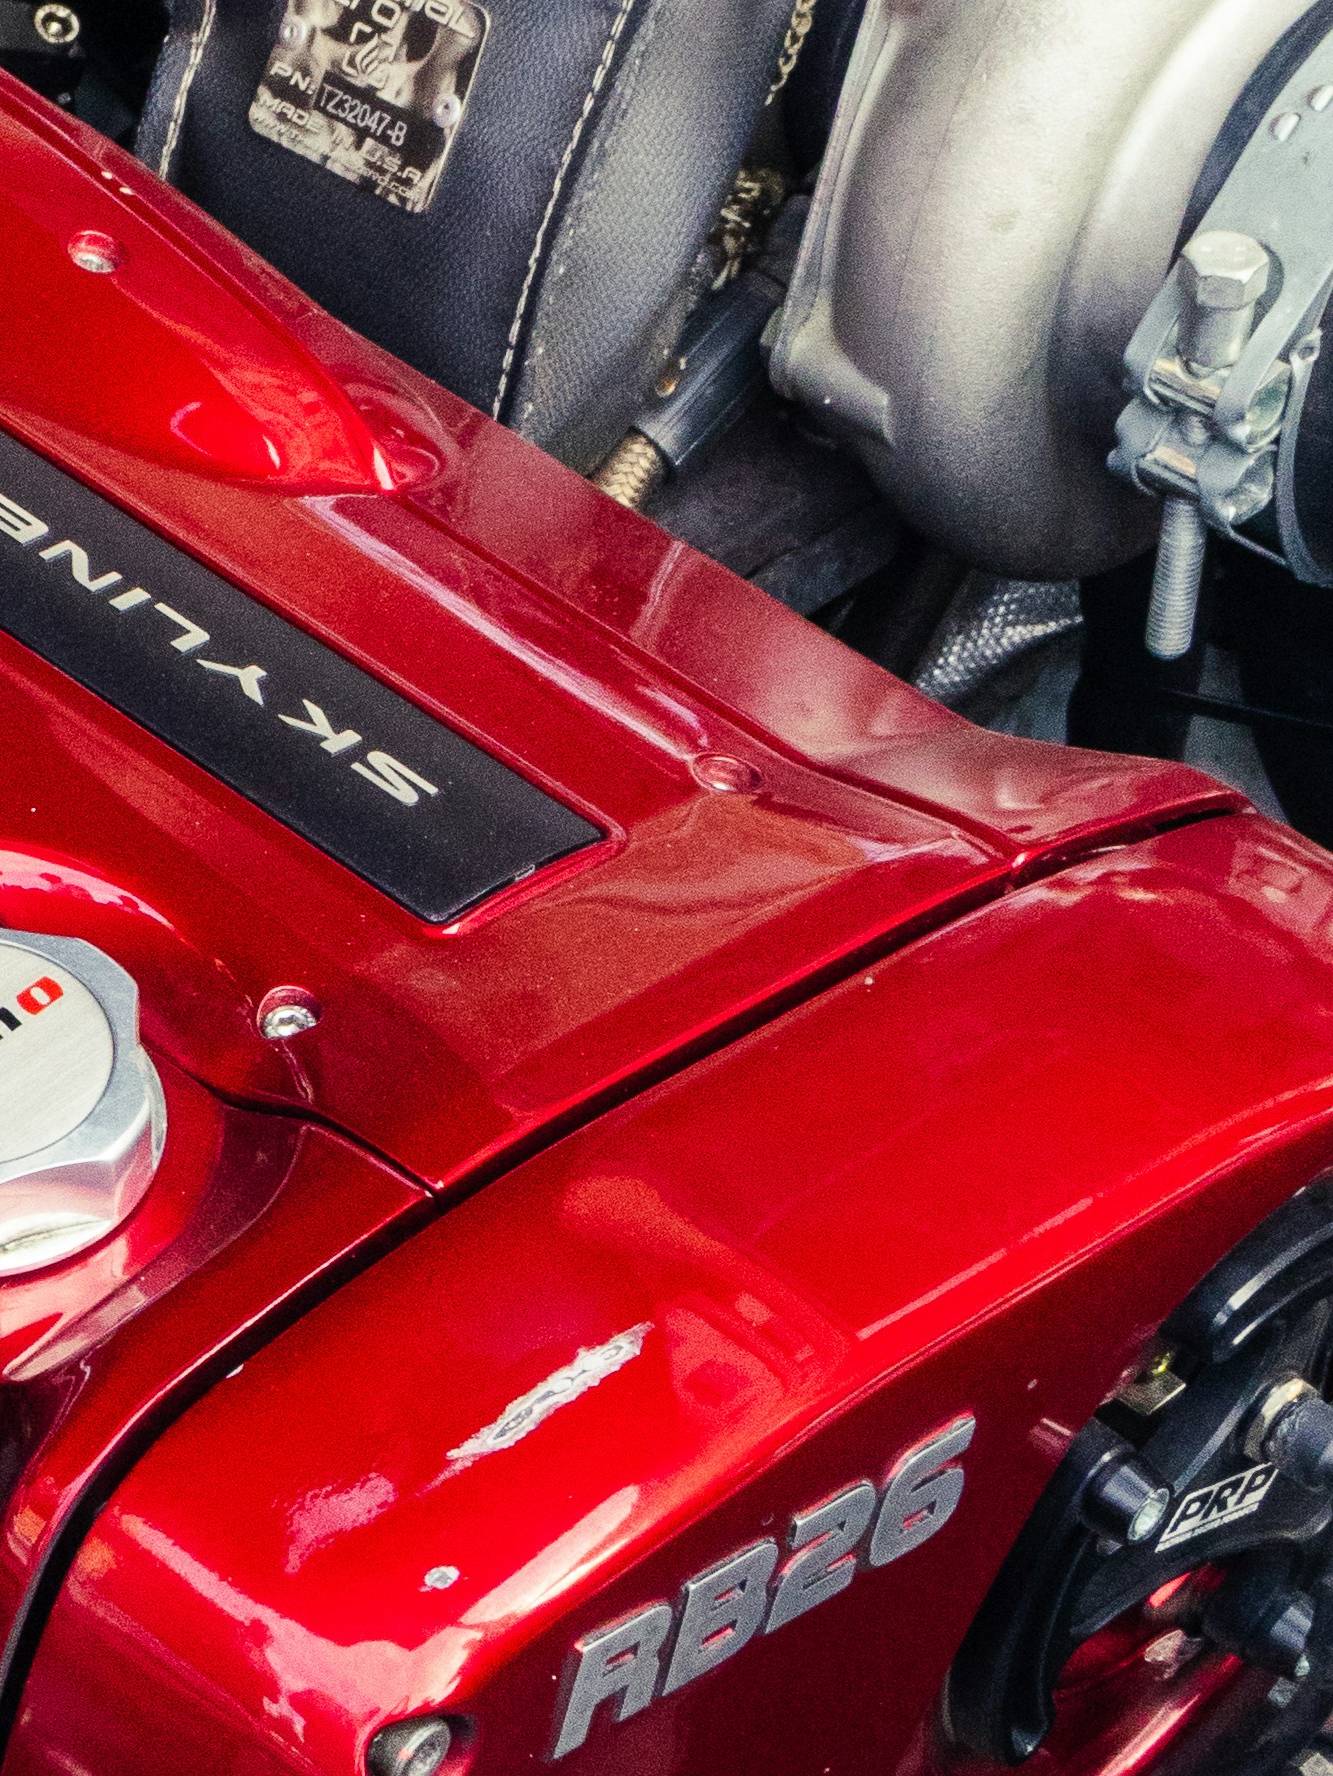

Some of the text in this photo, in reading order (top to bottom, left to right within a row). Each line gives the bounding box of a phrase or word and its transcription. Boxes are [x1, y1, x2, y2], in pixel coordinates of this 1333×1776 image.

[270, 62, 407, 146] PN: TZ32047-B
[1170, 1467, 1277, 1531] PRP
[552, 1413, 976, 1761] RB26
